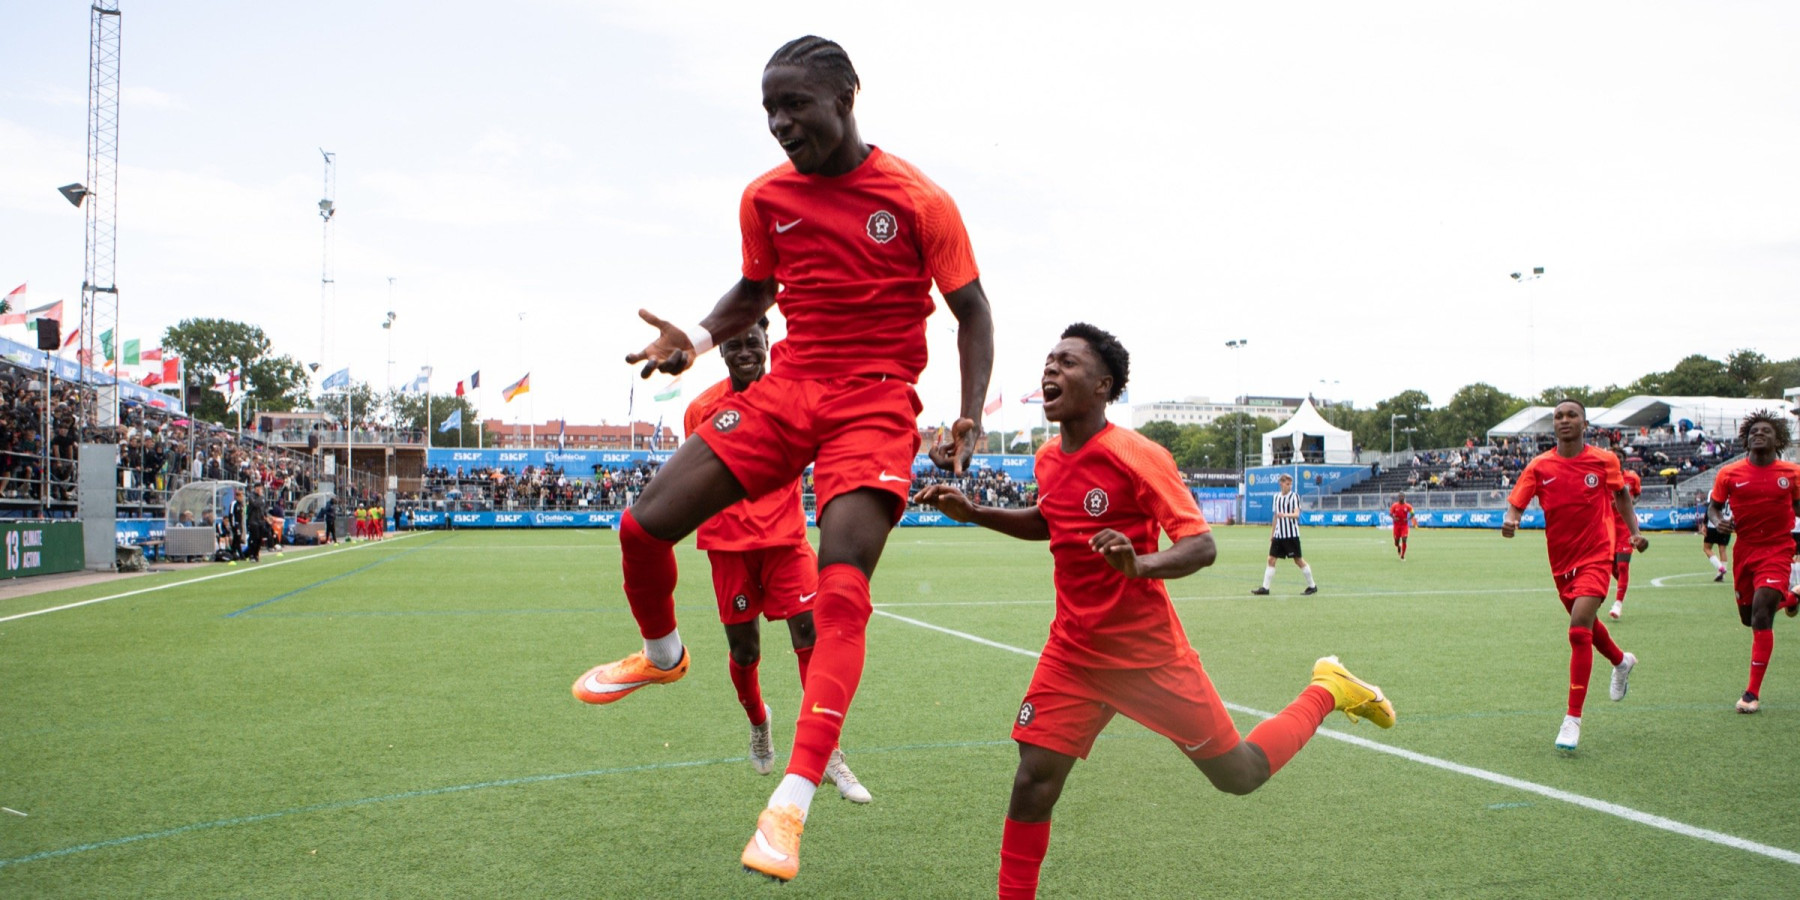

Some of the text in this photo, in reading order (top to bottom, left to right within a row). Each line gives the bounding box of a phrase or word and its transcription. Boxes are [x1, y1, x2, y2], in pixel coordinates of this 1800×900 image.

[453, 452, 482, 461] SKF
[500, 452, 528, 461] SKF
[603, 453, 631, 462] SKF
[1002, 458, 1027, 466] SKF
[454, 514, 481, 523] SKF
[496, 514, 522, 523] SKF
[589, 514, 615, 523] SKF
[919, 515, 942, 523] SKF
[23, 529, 42, 547] CLIMATE
[6, 530, 19, 570] 13
[23, 551, 41, 568] ACTION
